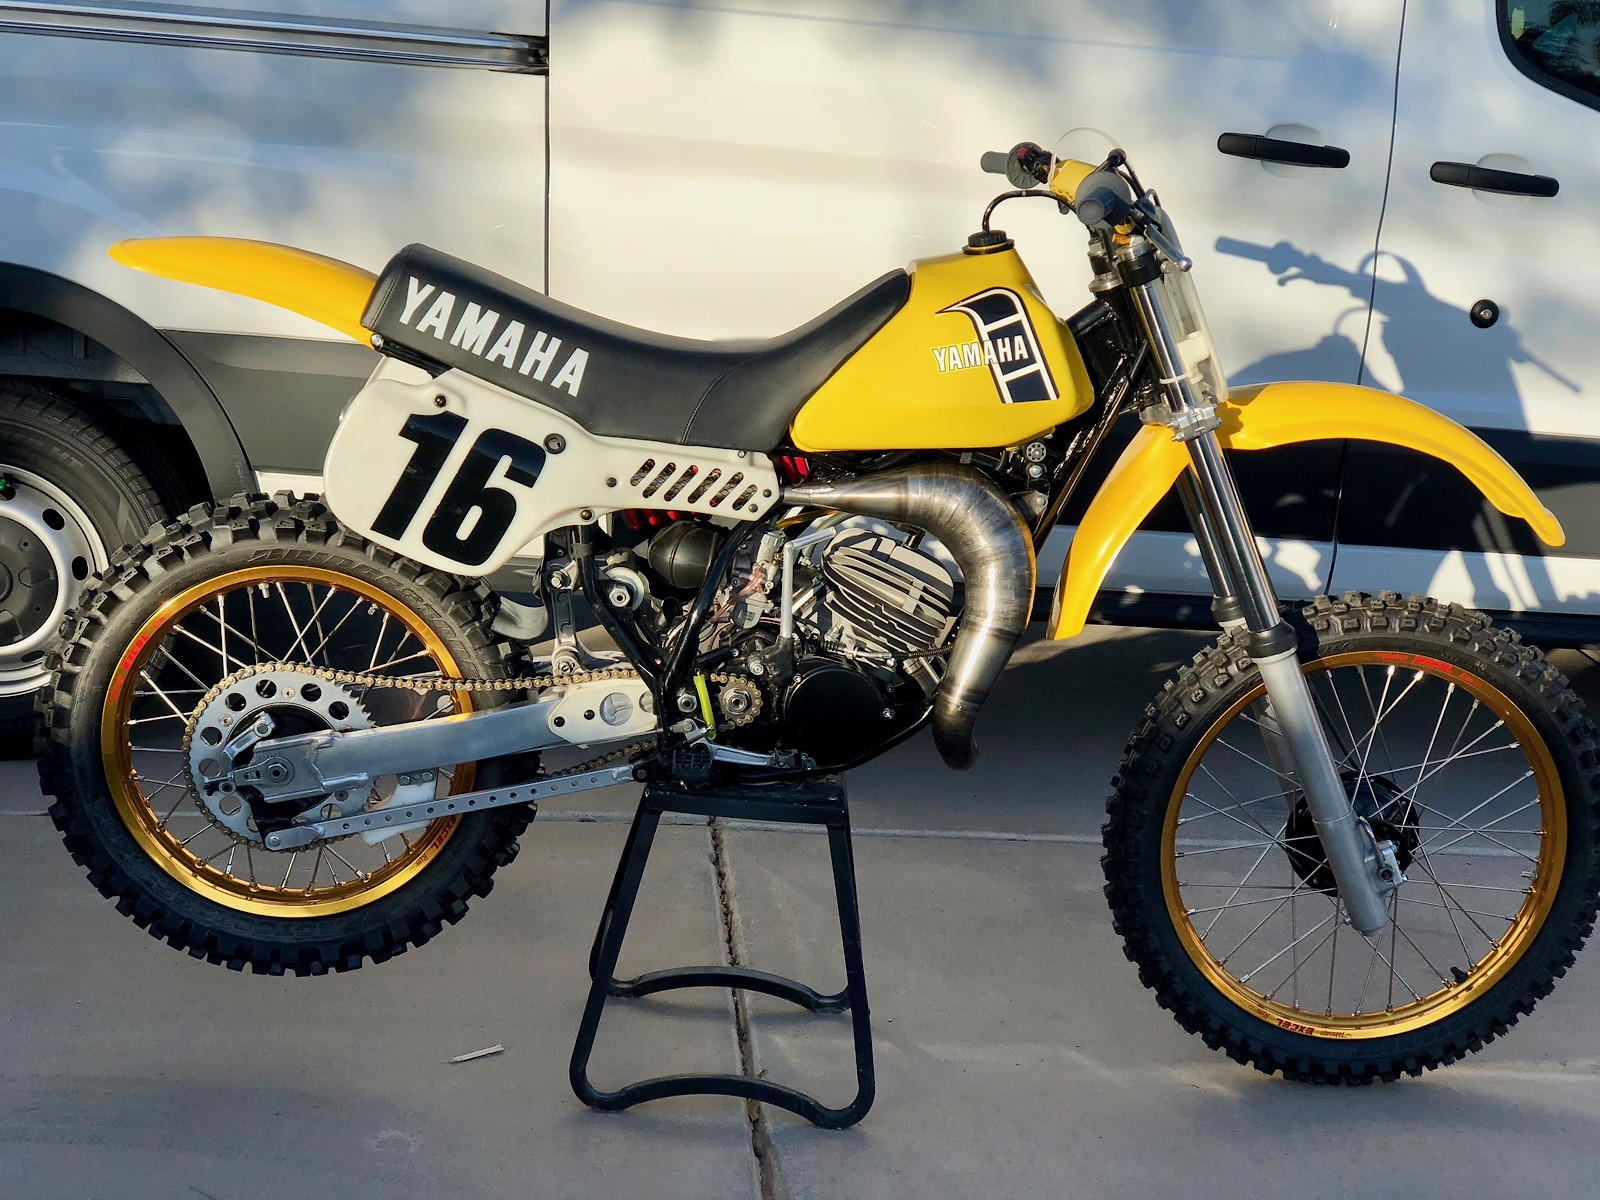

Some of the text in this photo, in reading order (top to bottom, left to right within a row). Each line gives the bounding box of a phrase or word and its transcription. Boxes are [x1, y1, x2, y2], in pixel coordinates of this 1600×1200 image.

[399, 275, 590, 398] YAMAHA
[931, 335, 1029, 373] YAMAHA
[369, 409, 547, 567] 16
[1275, 1017, 1316, 1036] EXCEL
